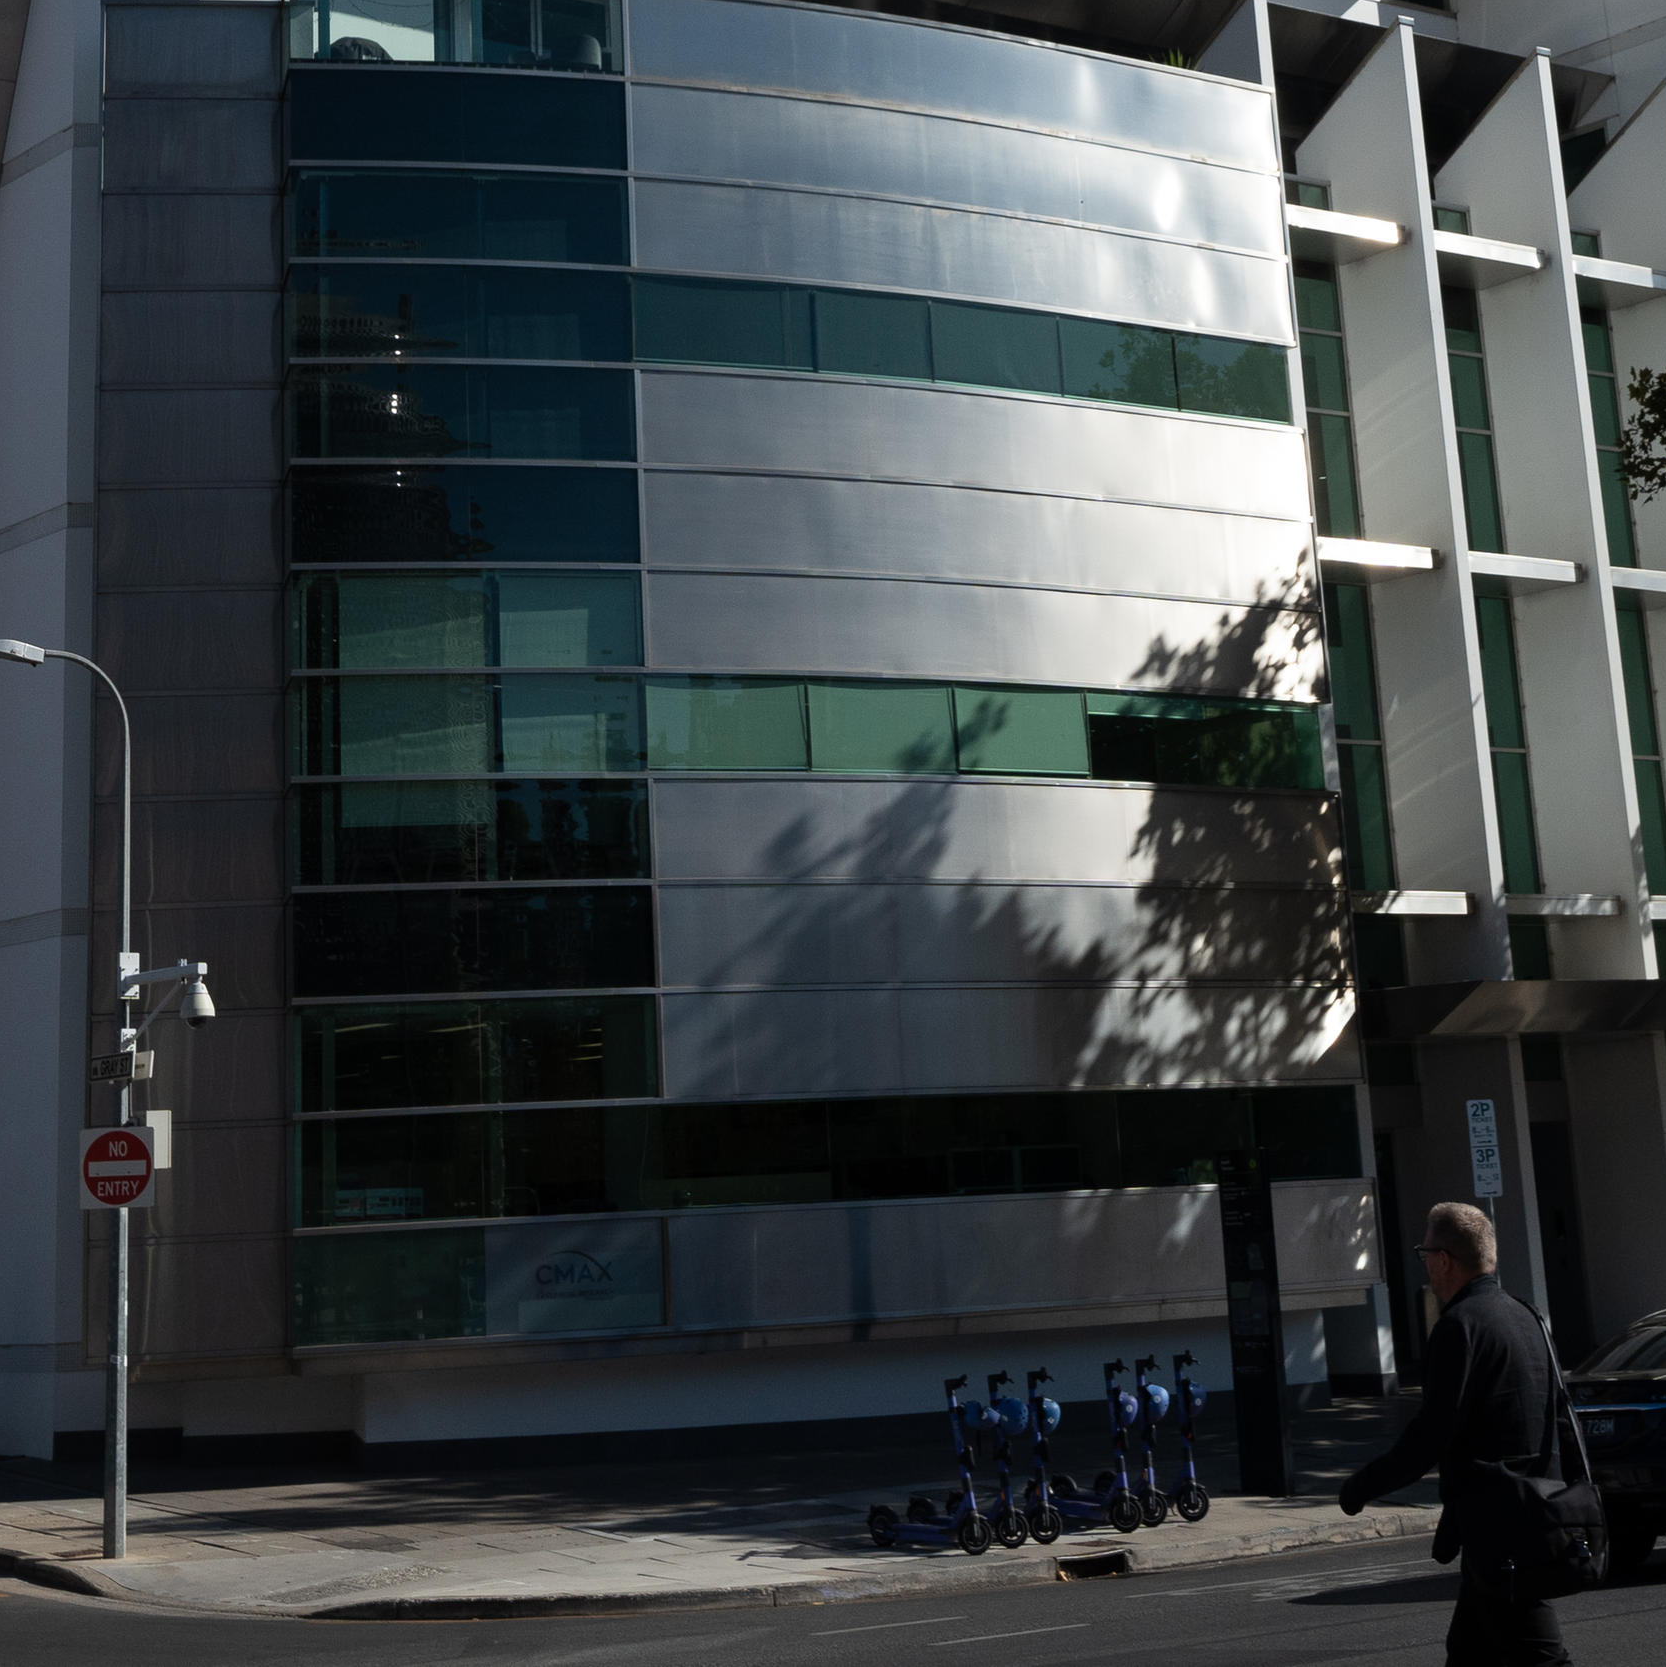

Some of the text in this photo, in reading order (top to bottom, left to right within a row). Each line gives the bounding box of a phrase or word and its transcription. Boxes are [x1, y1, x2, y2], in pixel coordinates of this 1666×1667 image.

[101, 1059, 119, 1076] GRAY
[120, 1057, 129, 1073] ST
[1470, 1102, 1490, 1117] 2P
[108, 1140, 128, 1158] NO
[1476, 1148, 1495, 1163] 3P
[97, 1180, 140, 1197] ENTRY
[535, 1261, 614, 1285] CMAX
